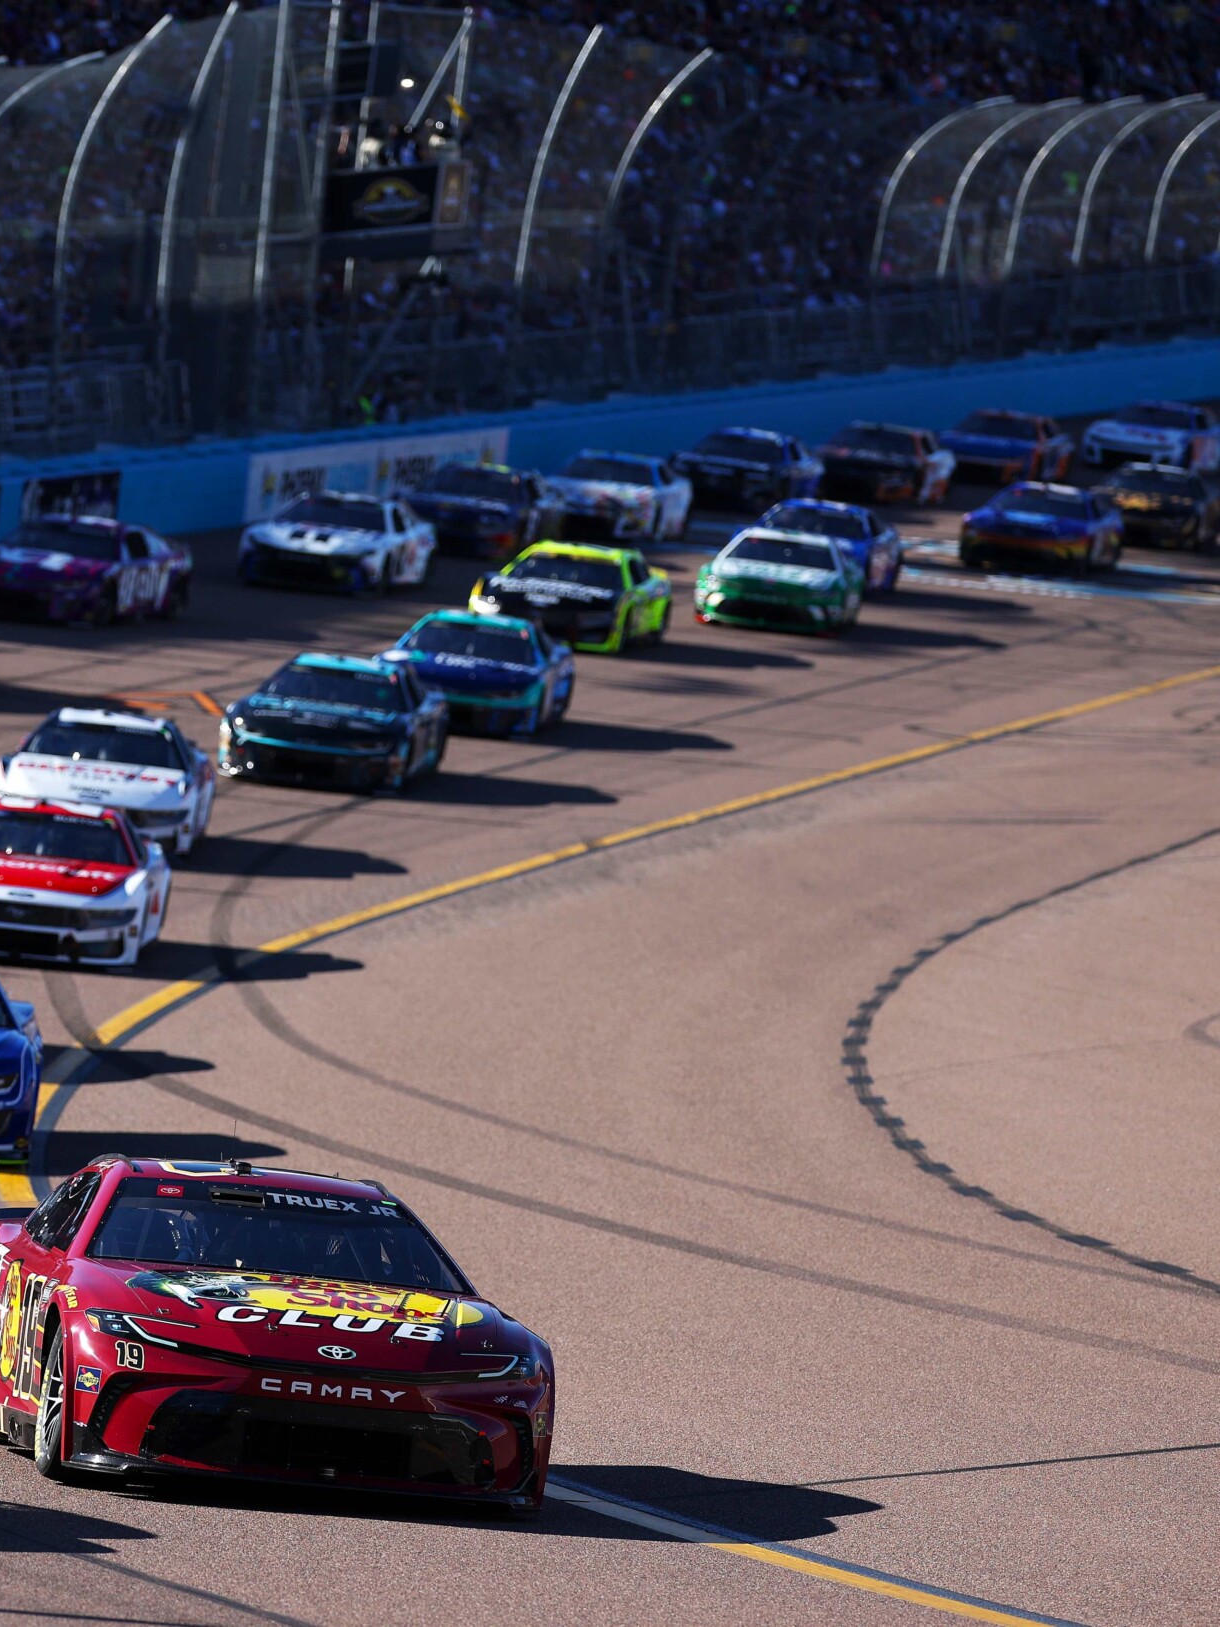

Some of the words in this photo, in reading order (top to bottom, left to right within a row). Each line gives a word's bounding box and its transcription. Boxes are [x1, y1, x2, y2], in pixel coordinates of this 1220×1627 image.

[266, 1192, 361, 1214] TRUEX
[369, 1205, 400, 1218] JR
[217, 1305, 445, 1342] CLUB
[115, 1340, 145, 1370] 19
[78, 1374, 99, 1385] SUNOCO
[261, 1377, 407, 1403] CAMRY
